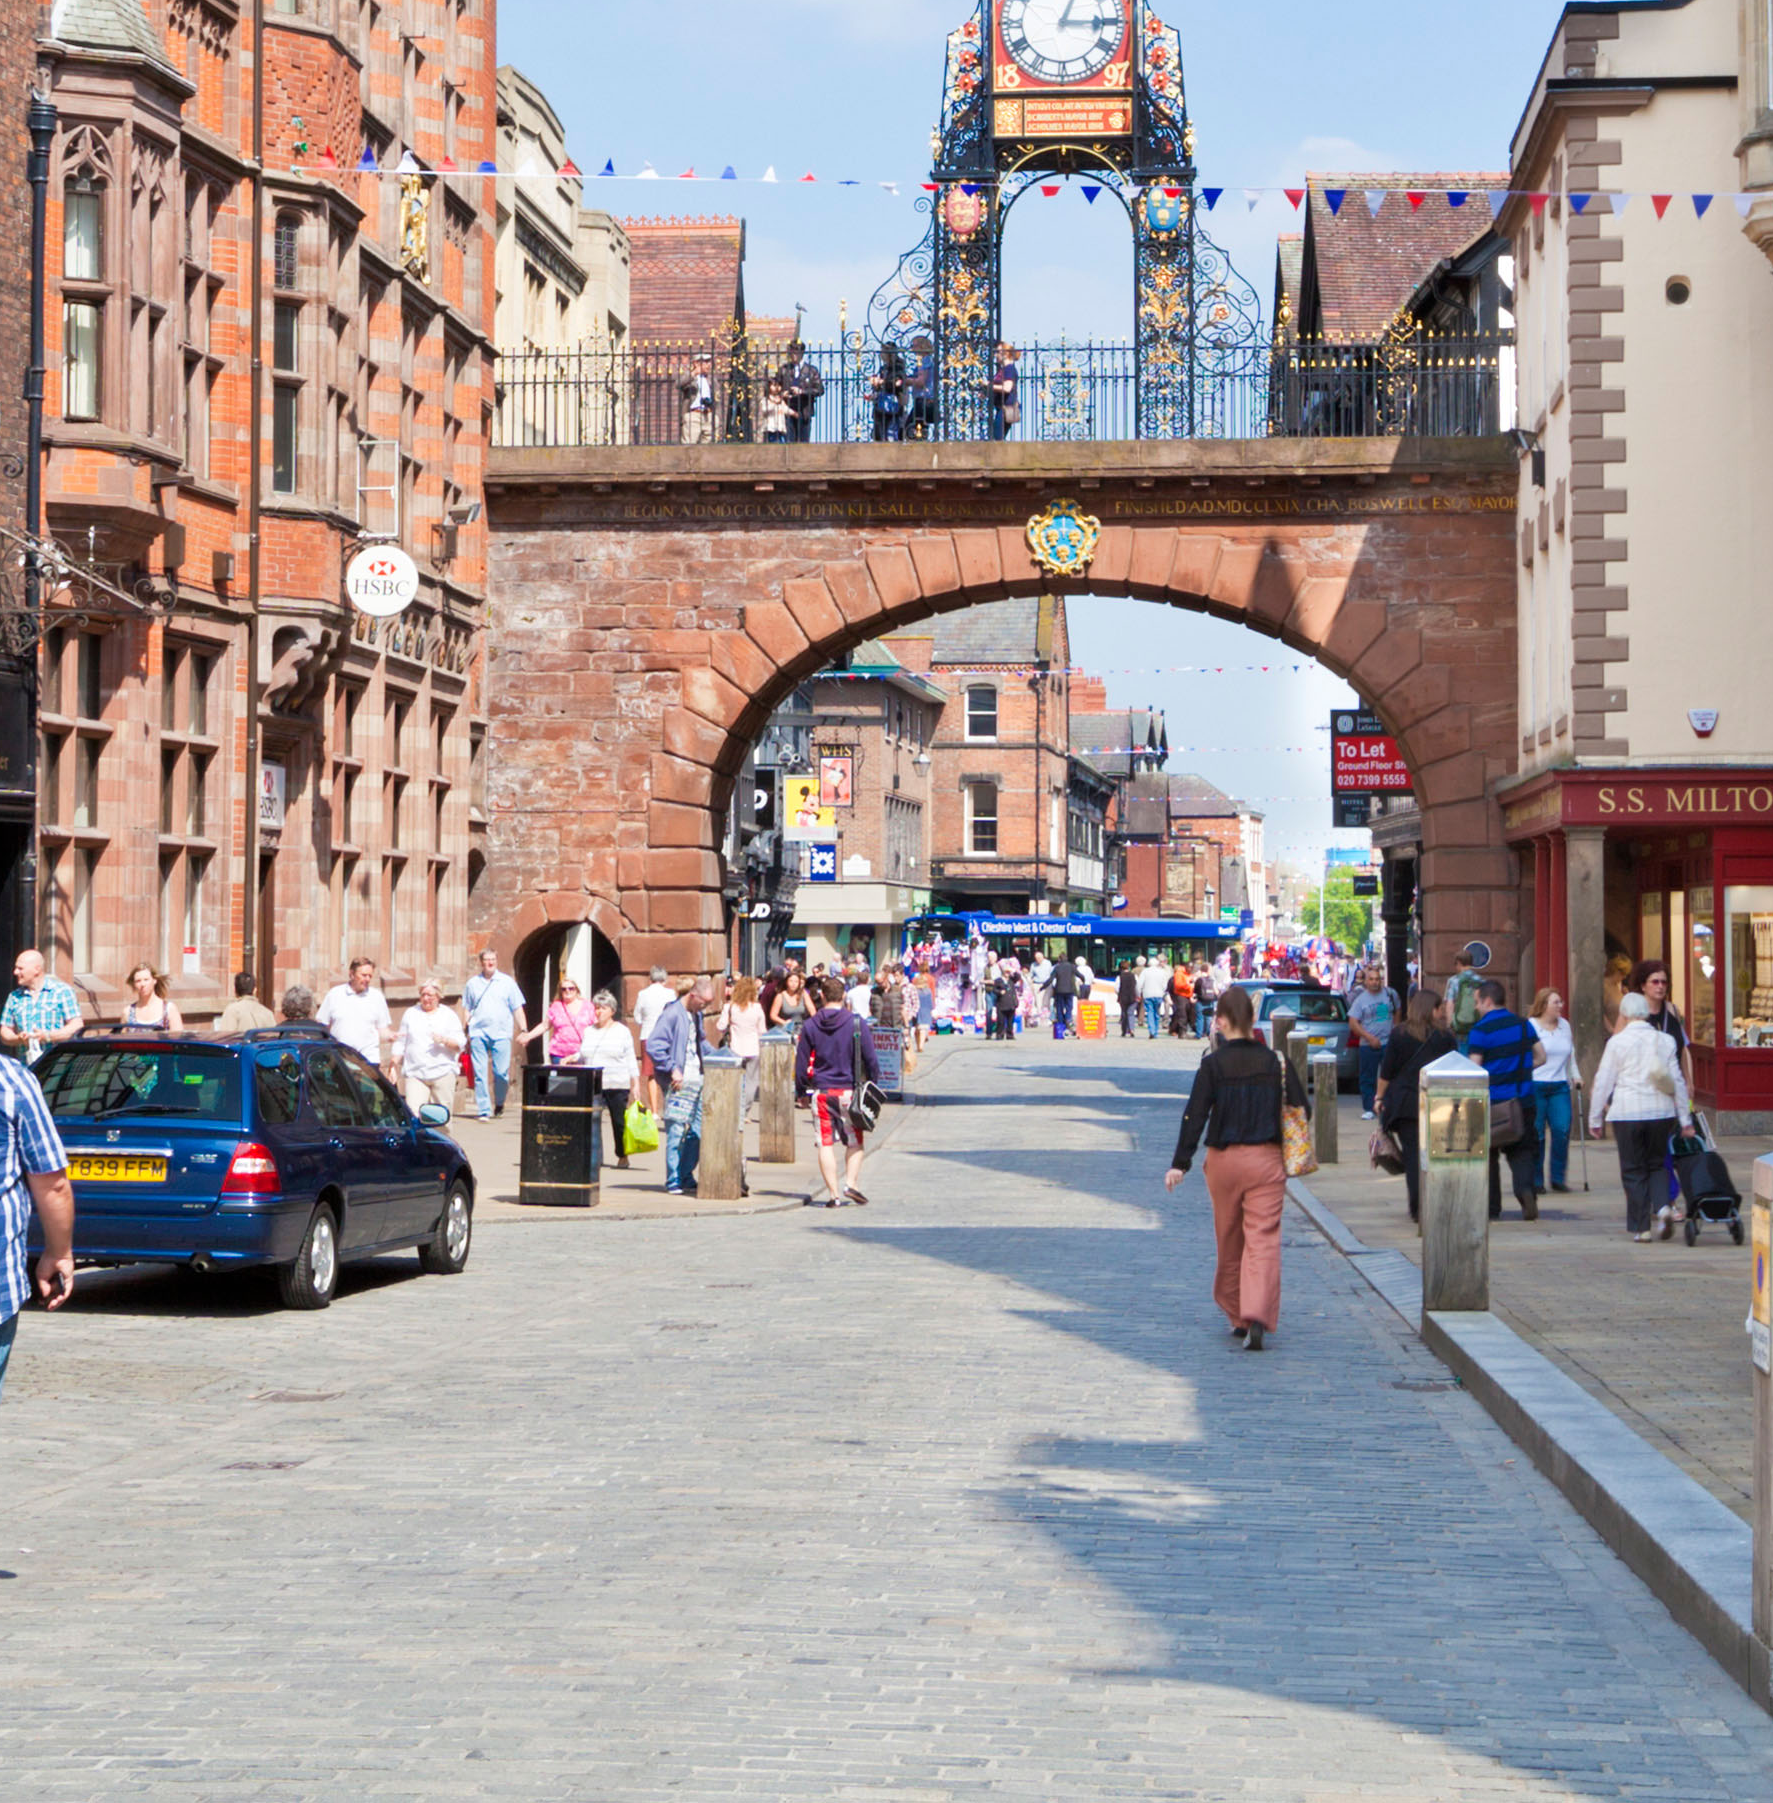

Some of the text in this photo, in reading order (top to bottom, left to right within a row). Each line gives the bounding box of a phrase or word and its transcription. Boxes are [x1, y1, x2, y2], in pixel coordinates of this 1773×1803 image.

[996, 63, 1022, 88] 18
[1102, 60, 1130, 88] 97
[353, 578, 411, 597] HSBC
[1337, 741, 1386, 758] To Let
[1337, 761, 1369, 771] Ground
[1370, 761, 1393, 771] Floor
[1337, 773, 1407, 786] 020 7399 5555
[753, 789, 768, 810] D
[1597, 786, 1654, 814] S.S.
[749, 902, 771, 918] JD
[69, 1159, 166, 1178] T839 FFM
